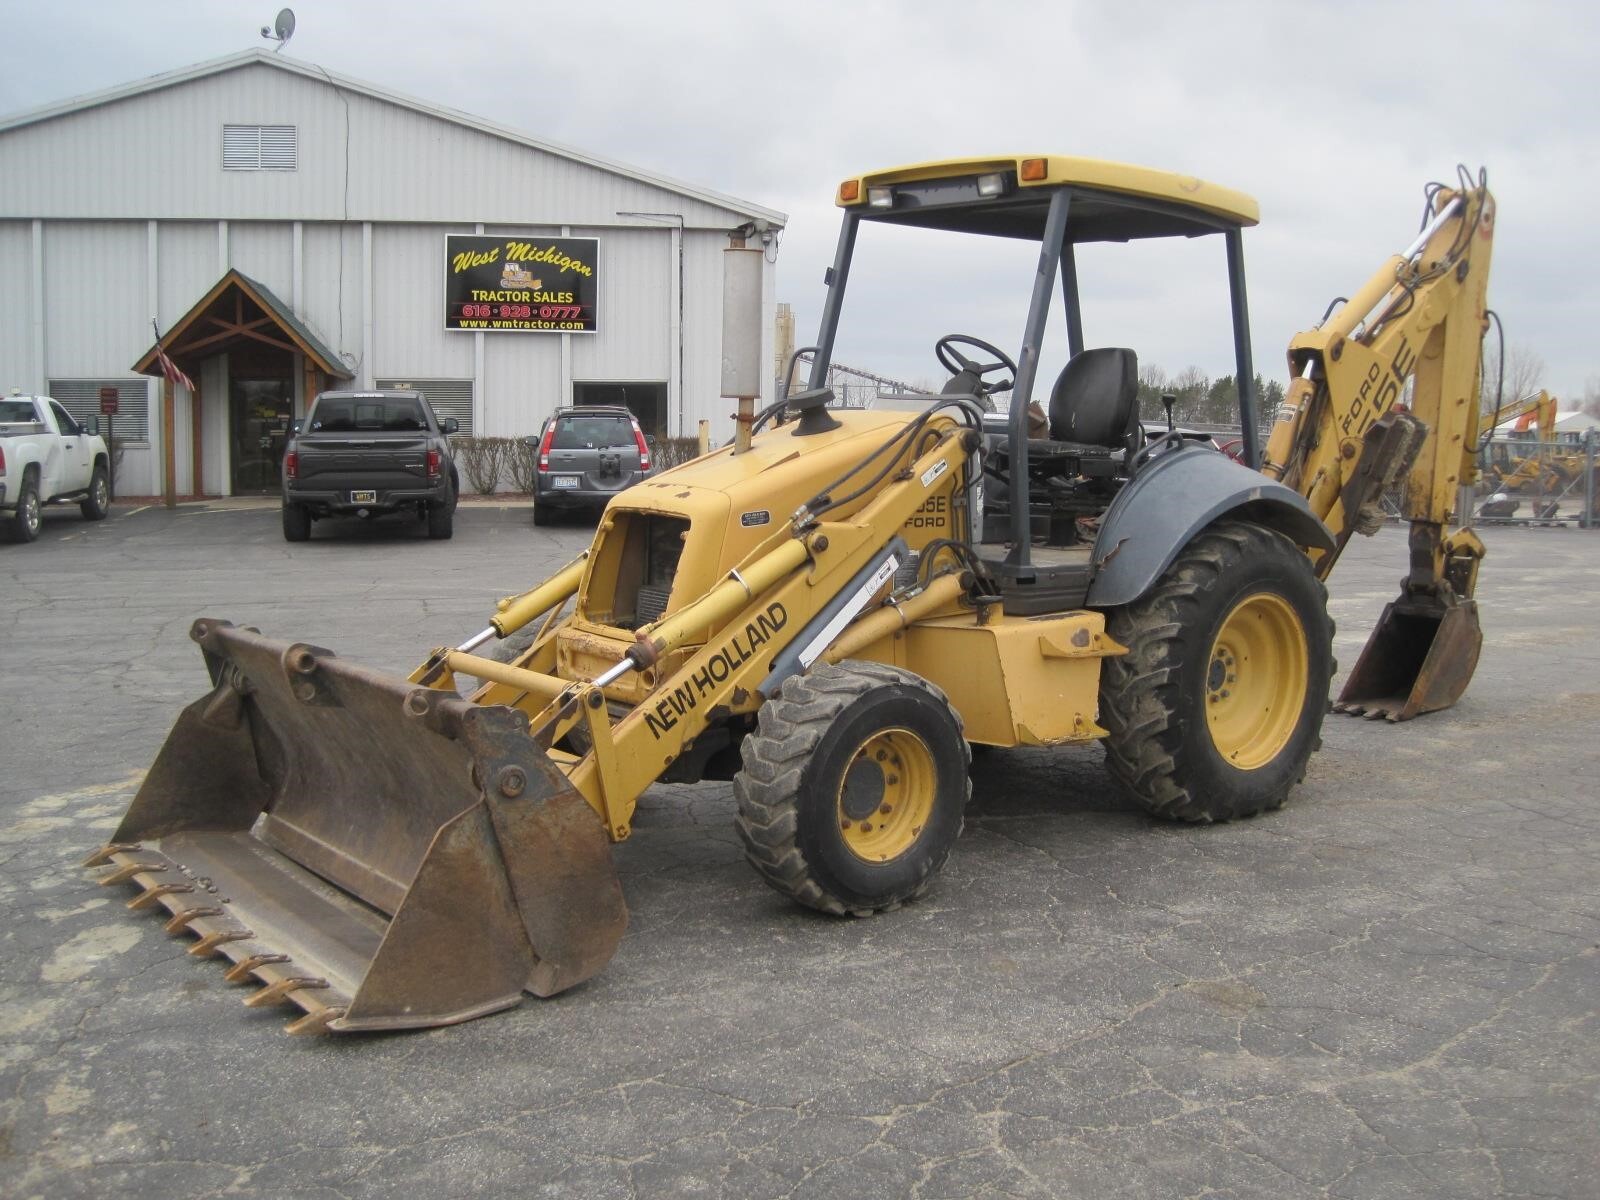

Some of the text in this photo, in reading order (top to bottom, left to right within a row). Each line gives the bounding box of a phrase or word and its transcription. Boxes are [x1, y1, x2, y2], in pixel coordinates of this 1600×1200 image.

[453, 241, 593, 277] West Michigan
[471, 290, 574, 304] TRACTOR SALES
[459, 319, 585, 330] www.wmtractor.com
[1342, 362, 1380, 435] FORD
[904, 516, 946, 529] FORD
[644, 602, 788, 740] NEW HOLLAND
